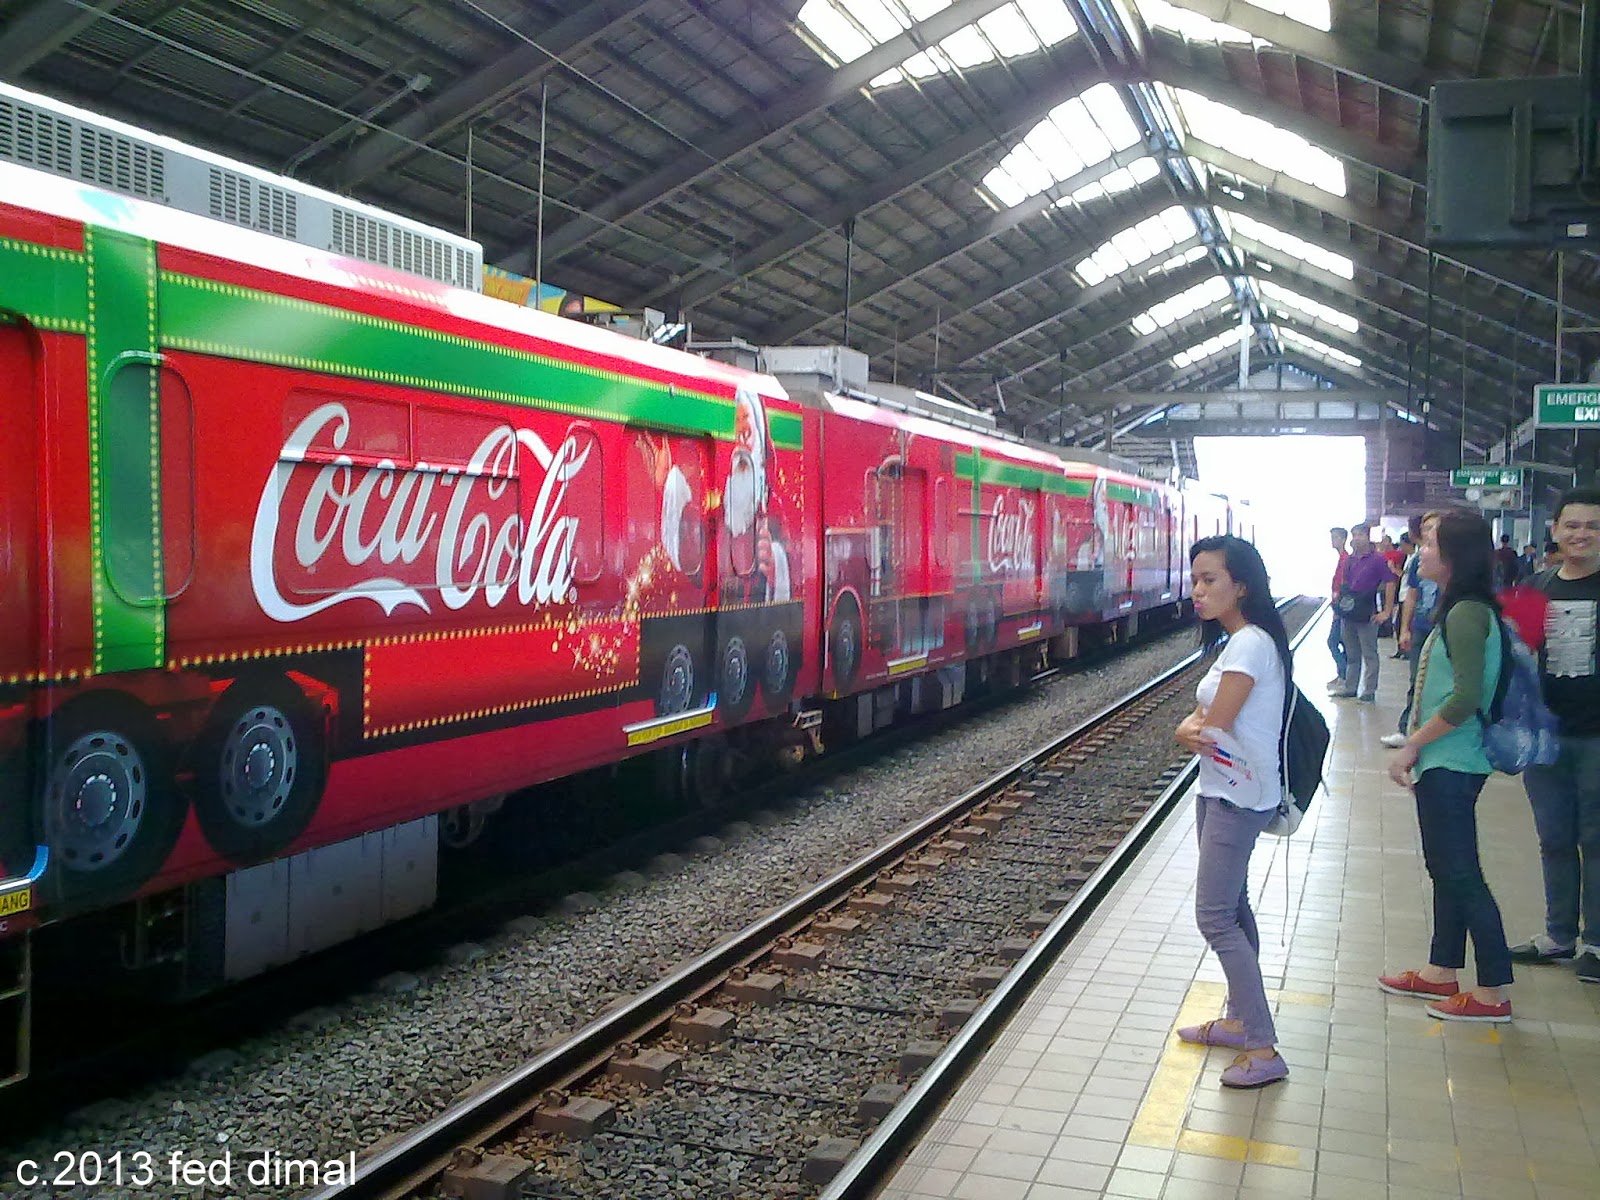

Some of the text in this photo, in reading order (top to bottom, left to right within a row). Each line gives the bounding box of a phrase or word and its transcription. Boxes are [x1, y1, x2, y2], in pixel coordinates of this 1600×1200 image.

[1547, 392, 1600, 405] EMERG
[1575, 406, 1600, 421] EXI
[250, 402, 592, 622] Coca-Cola
